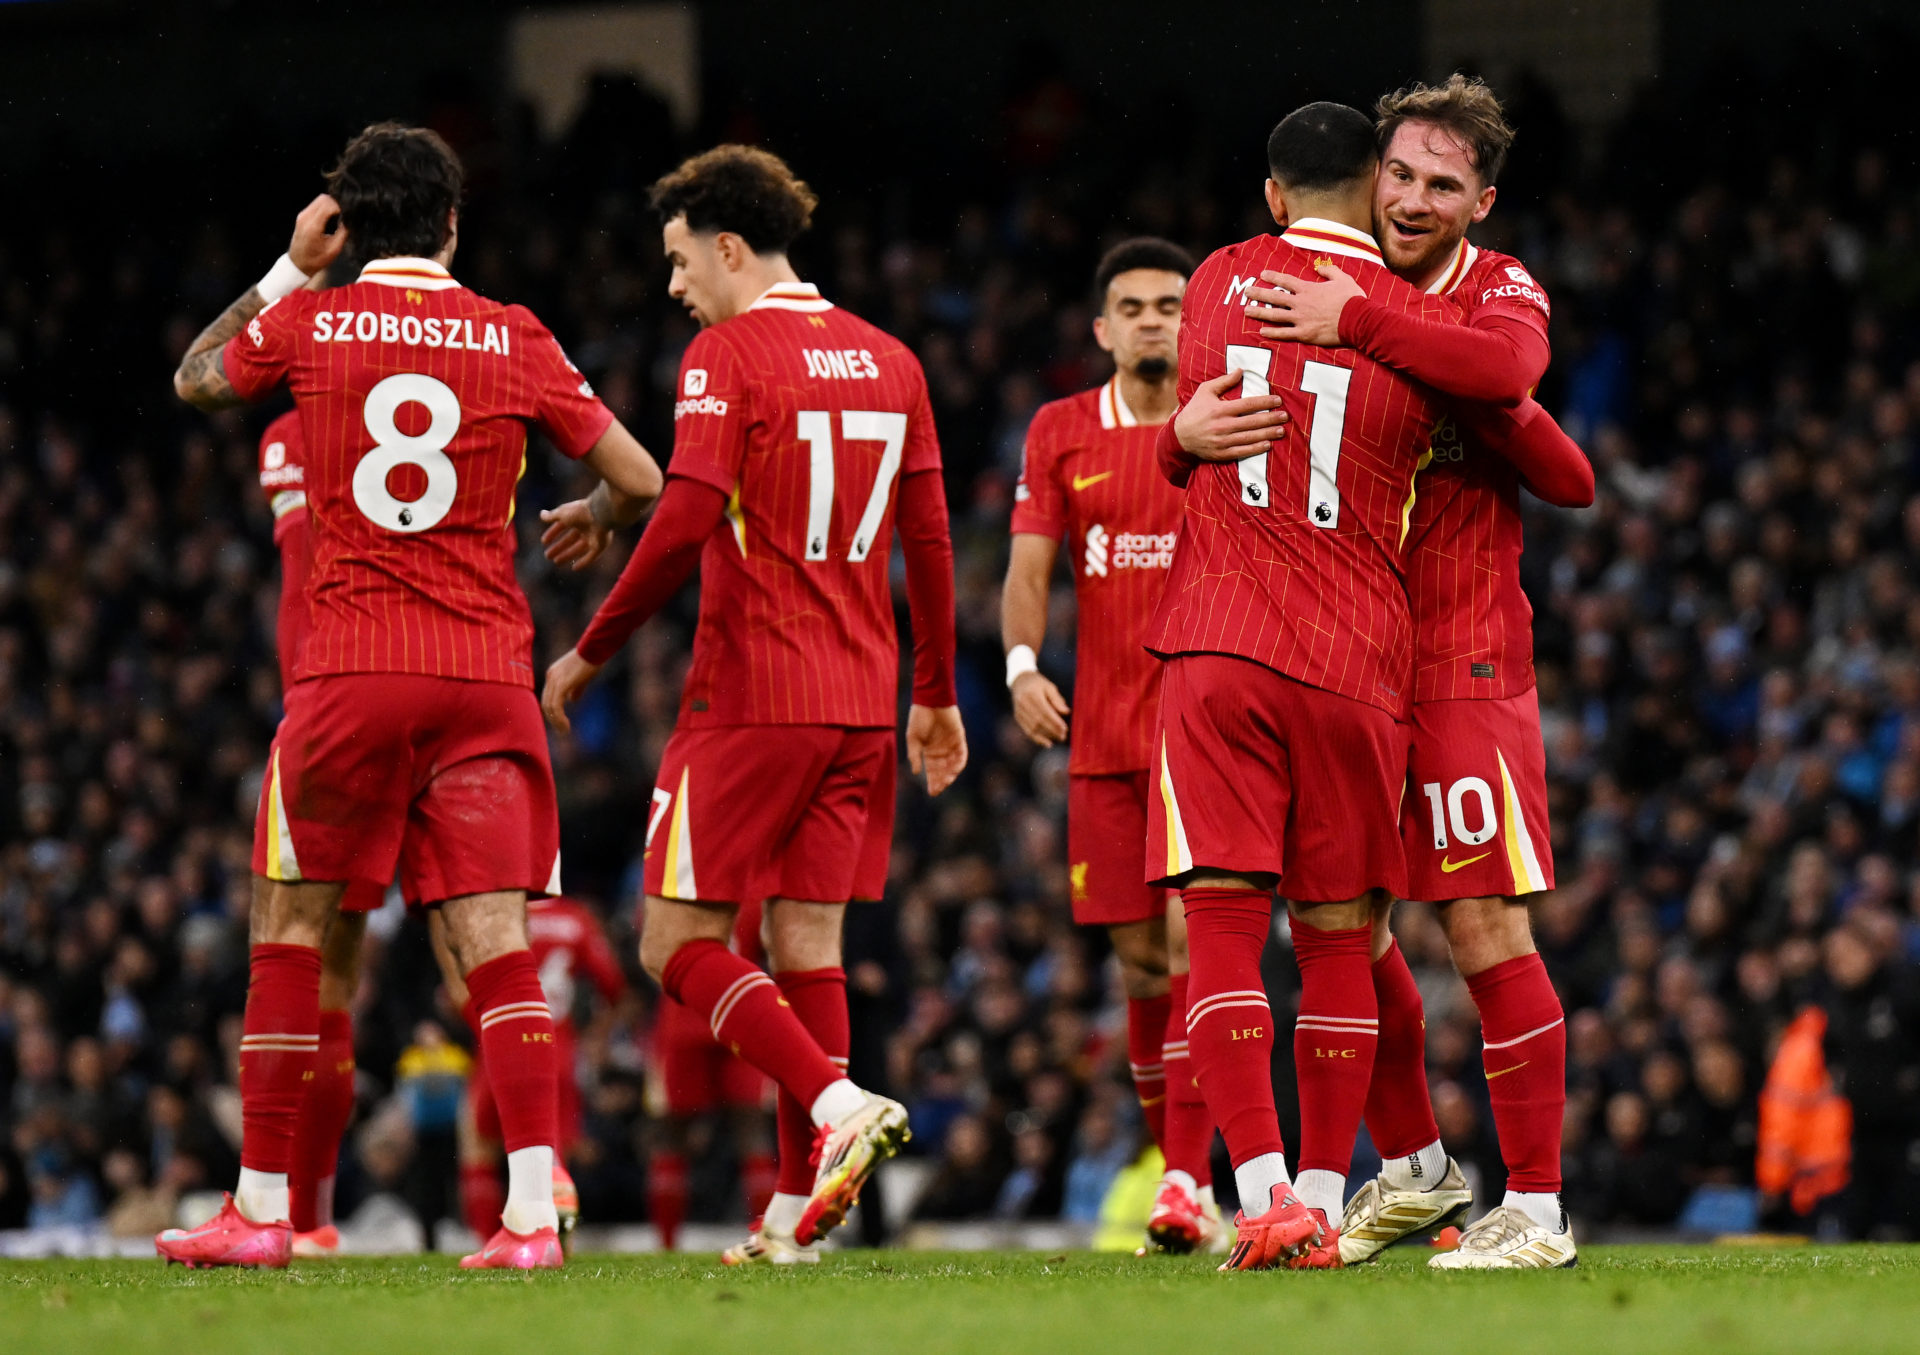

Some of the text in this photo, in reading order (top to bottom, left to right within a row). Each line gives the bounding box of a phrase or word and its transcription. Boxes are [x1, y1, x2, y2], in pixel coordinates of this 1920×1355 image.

[312, 311, 510, 356] SZOBOSZLAI
[803, 349, 880, 379] JONES
[352, 372, 461, 533] 8
[1226, 344, 1352, 529] 11
[797, 410, 907, 562] 17
[1423, 776, 1498, 850] 10
[522, 1033, 553, 1044] LFC
[1231, 1026, 1263, 1041] LFC
[1315, 1048, 1356, 1058] LFC
